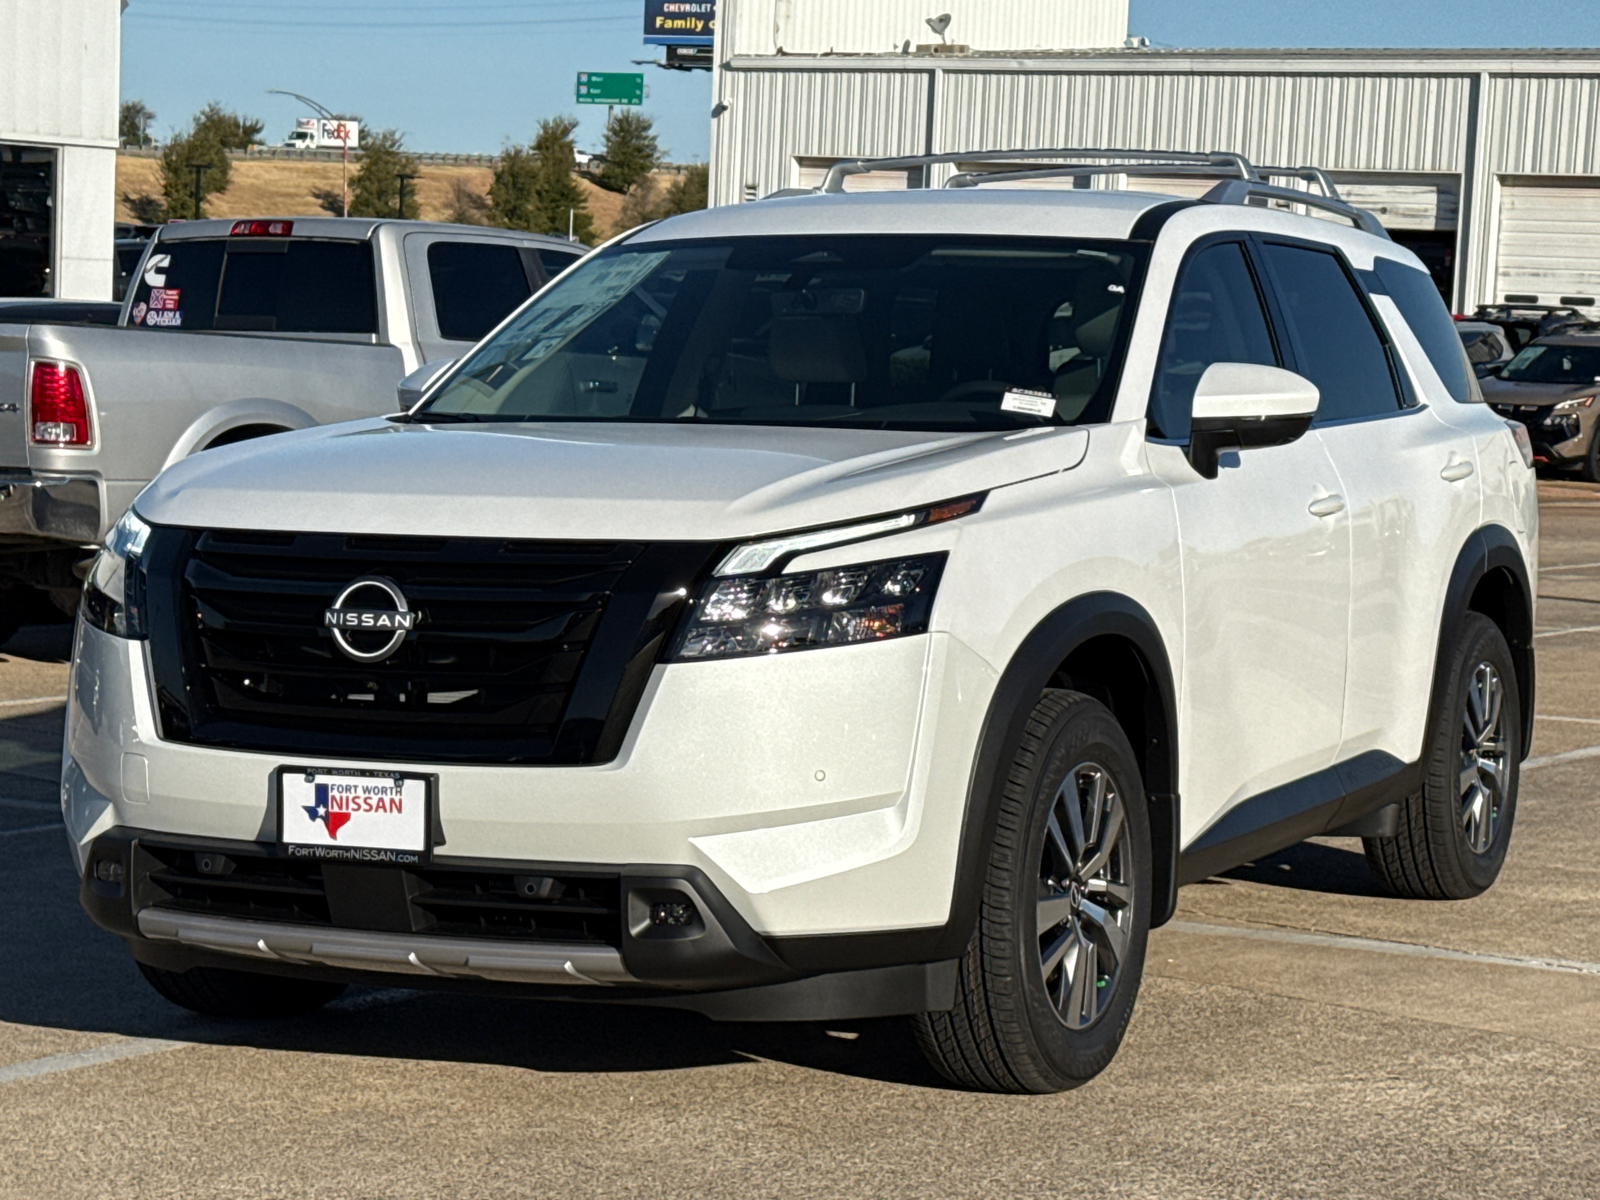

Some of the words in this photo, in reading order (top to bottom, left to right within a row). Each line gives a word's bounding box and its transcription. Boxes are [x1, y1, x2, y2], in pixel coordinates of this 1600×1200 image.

[663, 3, 712, 13] CHEVROLET
[655, 16, 704, 32] Family
[325, 611, 410, 628] NISSAN
[307, 768, 329, 776] FORT
[331, 769, 361, 777] WORTH
[372, 770, 401, 779] TEXAS
[330, 783, 359, 794] FORT
[361, 784, 403, 797] WORTH
[330, 795, 403, 814] NISSAN
